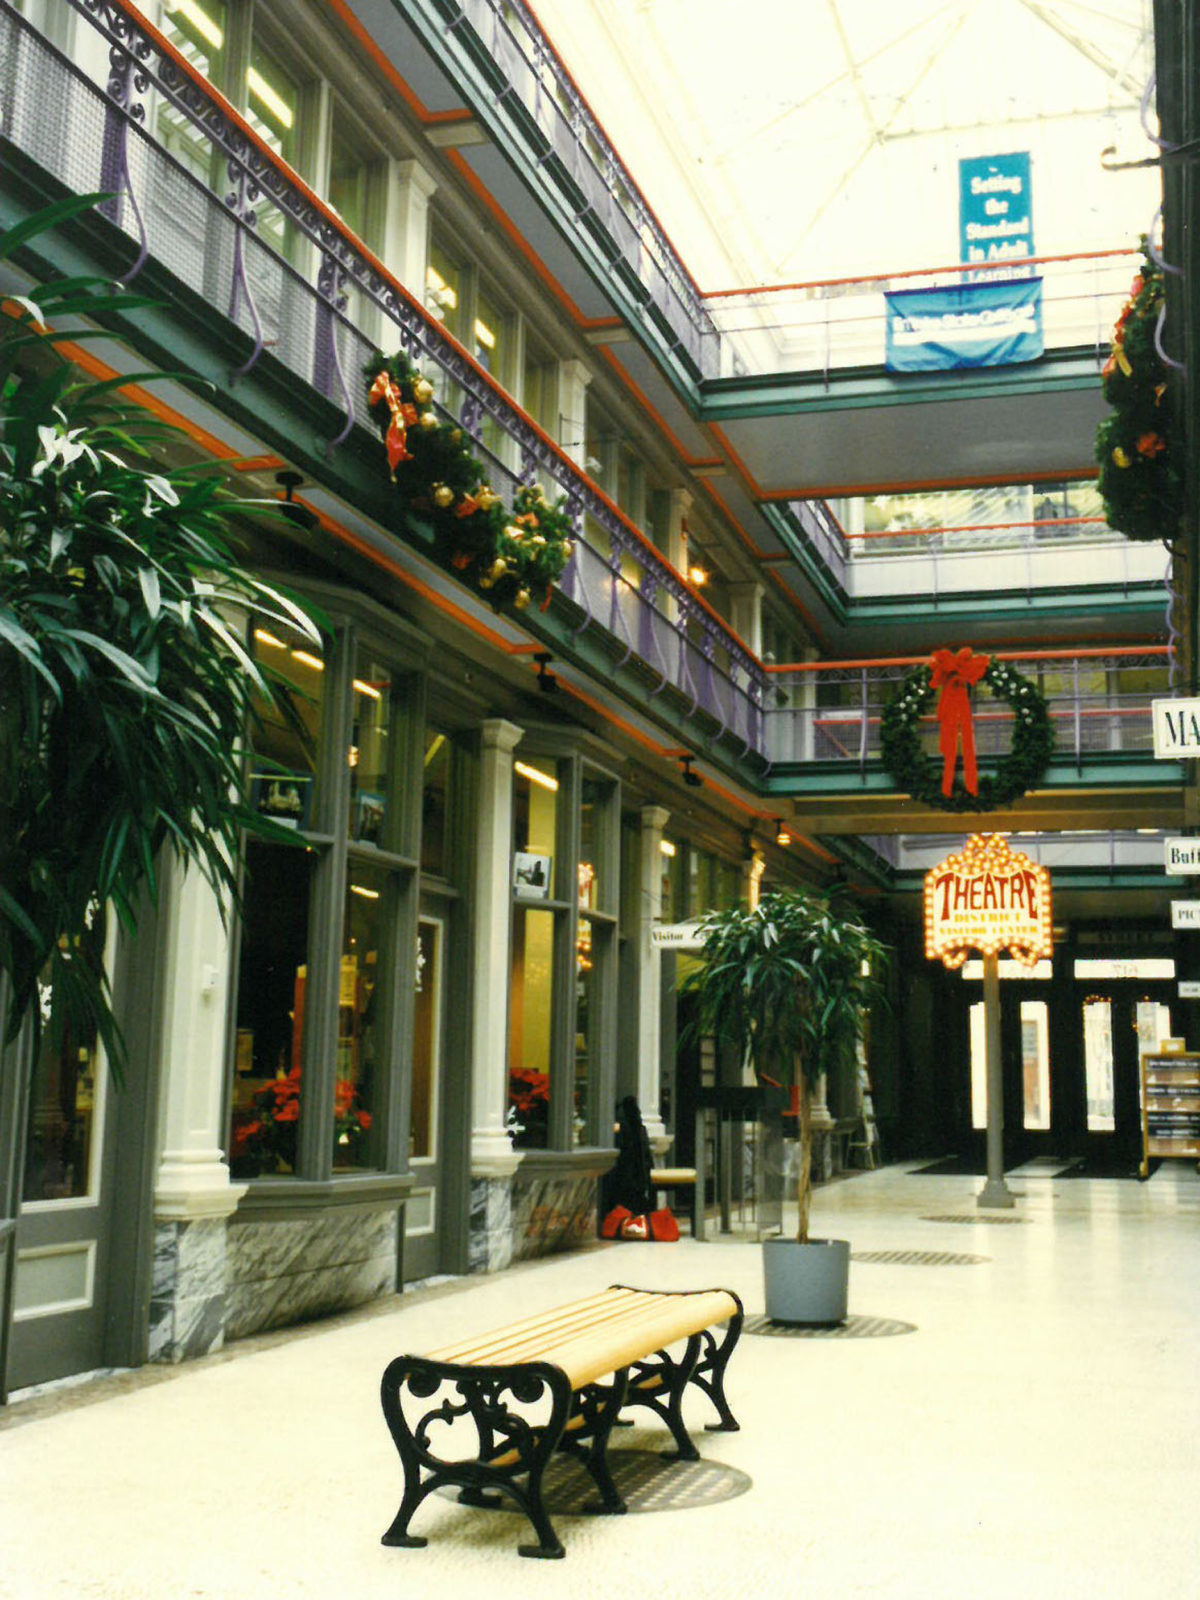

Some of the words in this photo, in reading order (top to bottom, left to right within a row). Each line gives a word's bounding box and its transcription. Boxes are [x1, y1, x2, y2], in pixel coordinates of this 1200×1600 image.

[971, 174, 1022, 195] Setting
[984, 197, 1009, 216] the
[966, 216, 1029, 240] Standard
[989, 240, 1028, 259] Adult
[1163, 711, 1200, 746] MA
[935, 868, 1038, 921] THEATRE
[954, 912, 1020, 923] DISTRICT
[652, 931, 683, 941] Visitor
[939, 927, 987, 935] VISITOR
[991, 926, 1038, 935] CENTER
